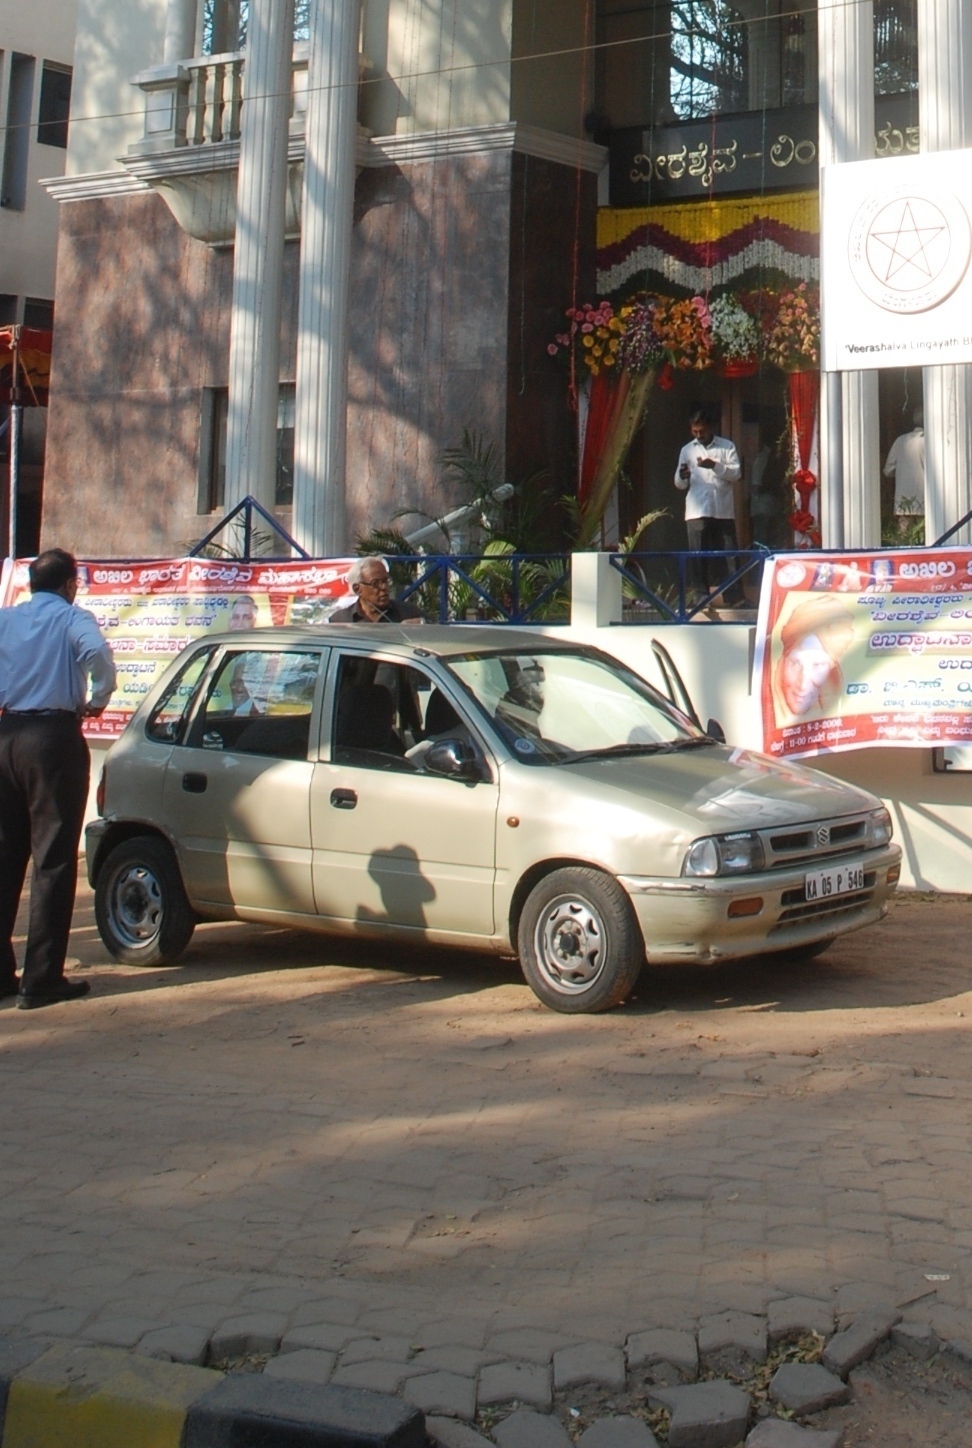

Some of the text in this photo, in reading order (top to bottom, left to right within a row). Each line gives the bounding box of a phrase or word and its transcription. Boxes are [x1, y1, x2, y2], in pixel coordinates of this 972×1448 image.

[910, 337, 960, 352] Lingayath
[899, 559, 956, 579] ಅಖಿಲ
[807, 870, 864, 898] KA 05 P 546
